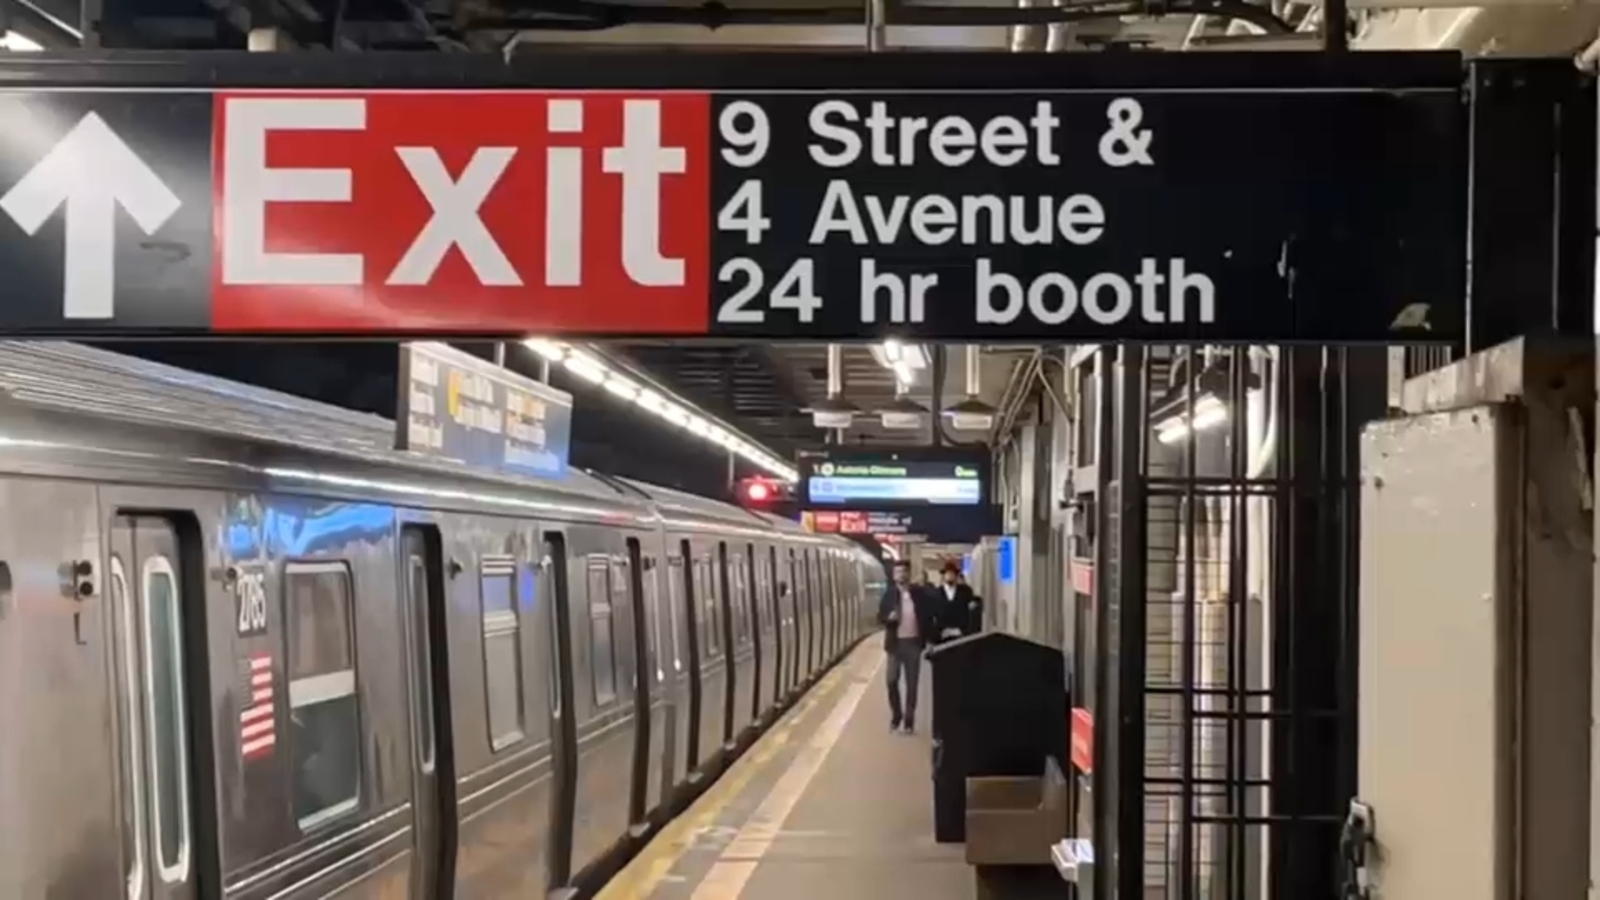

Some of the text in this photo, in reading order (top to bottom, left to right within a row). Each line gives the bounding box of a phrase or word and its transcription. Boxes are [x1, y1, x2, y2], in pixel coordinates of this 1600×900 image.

[720, 97, 1154, 167] 9 Street &
[222, 98, 686, 287] Exit
[718, 180, 1105, 244] 4 Avenue
[718, 258, 1215, 323] 24 hr booth
